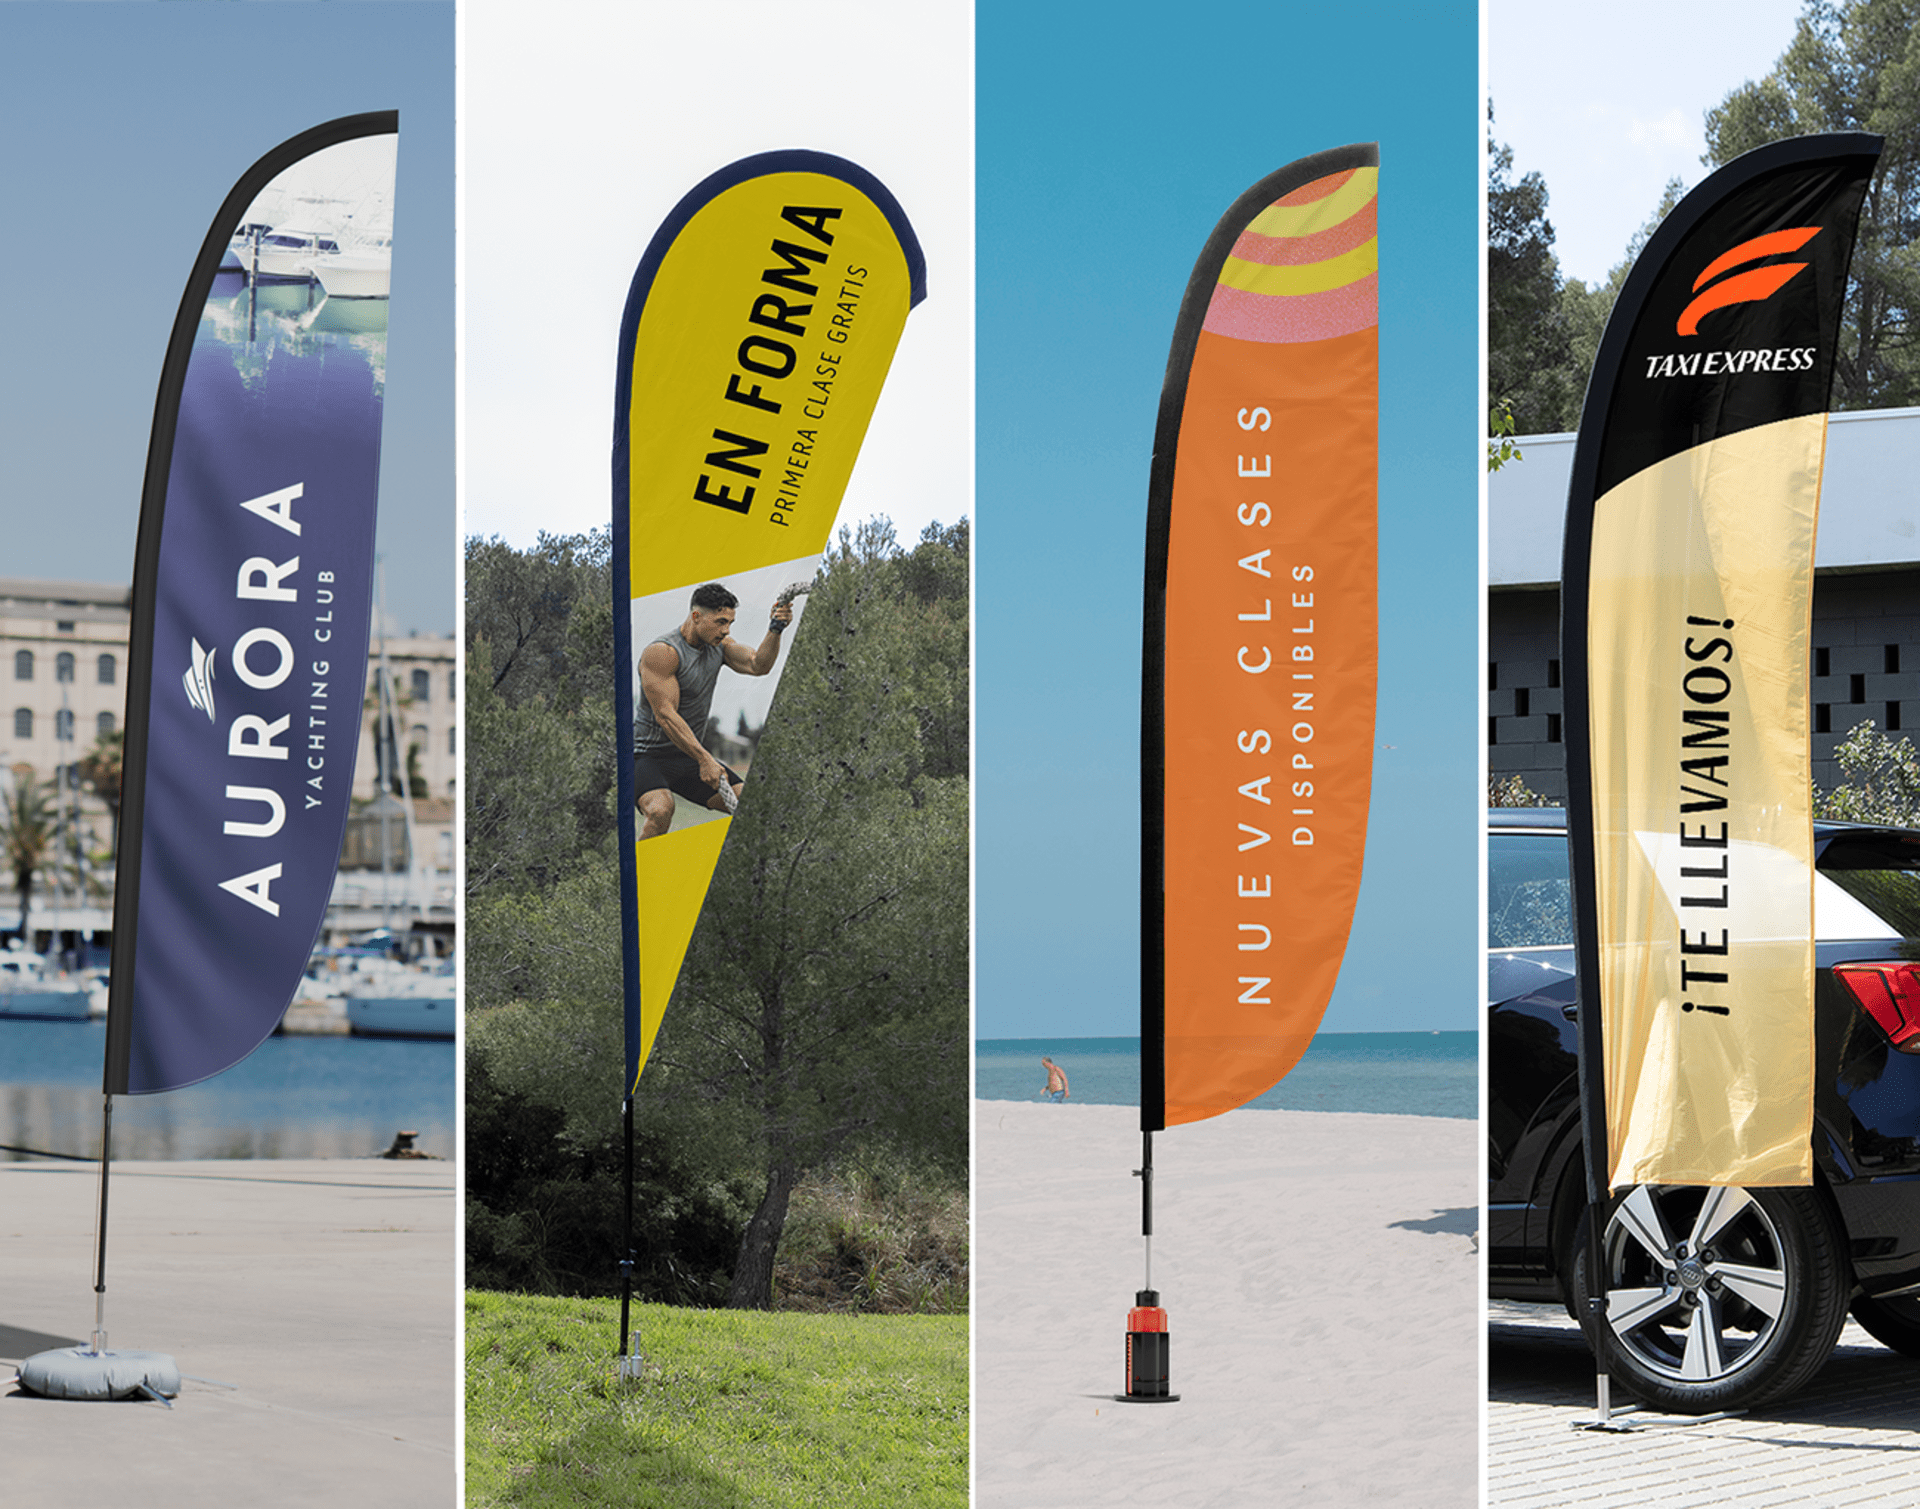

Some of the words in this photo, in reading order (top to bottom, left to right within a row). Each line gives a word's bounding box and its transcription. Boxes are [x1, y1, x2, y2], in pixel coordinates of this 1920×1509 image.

[724, 204, 843, 415] FORMA
[769, 429, 818, 527] PRIMERA
[803, 351, 842, 420] CLASE
[826, 264, 869, 344] GRATIS
[1646, 355, 1703, 378] TAXI
[1702, 347, 1816, 375] EXPRESS
[693, 427, 770, 515] EN
[1237, 406, 1272, 674] CLASES
[218, 481, 304, 918] AURORA
[314, 571, 335, 643] CLUB
[1291, 565, 1314, 846] DISPONIBLES
[304, 660, 331, 811] YACHTING
[1680, 615, 1735, 908] LLEVAMOS!
[1237, 730, 1272, 1005] NUEVAS
[1680, 929, 1730, 1016] ¡TE
